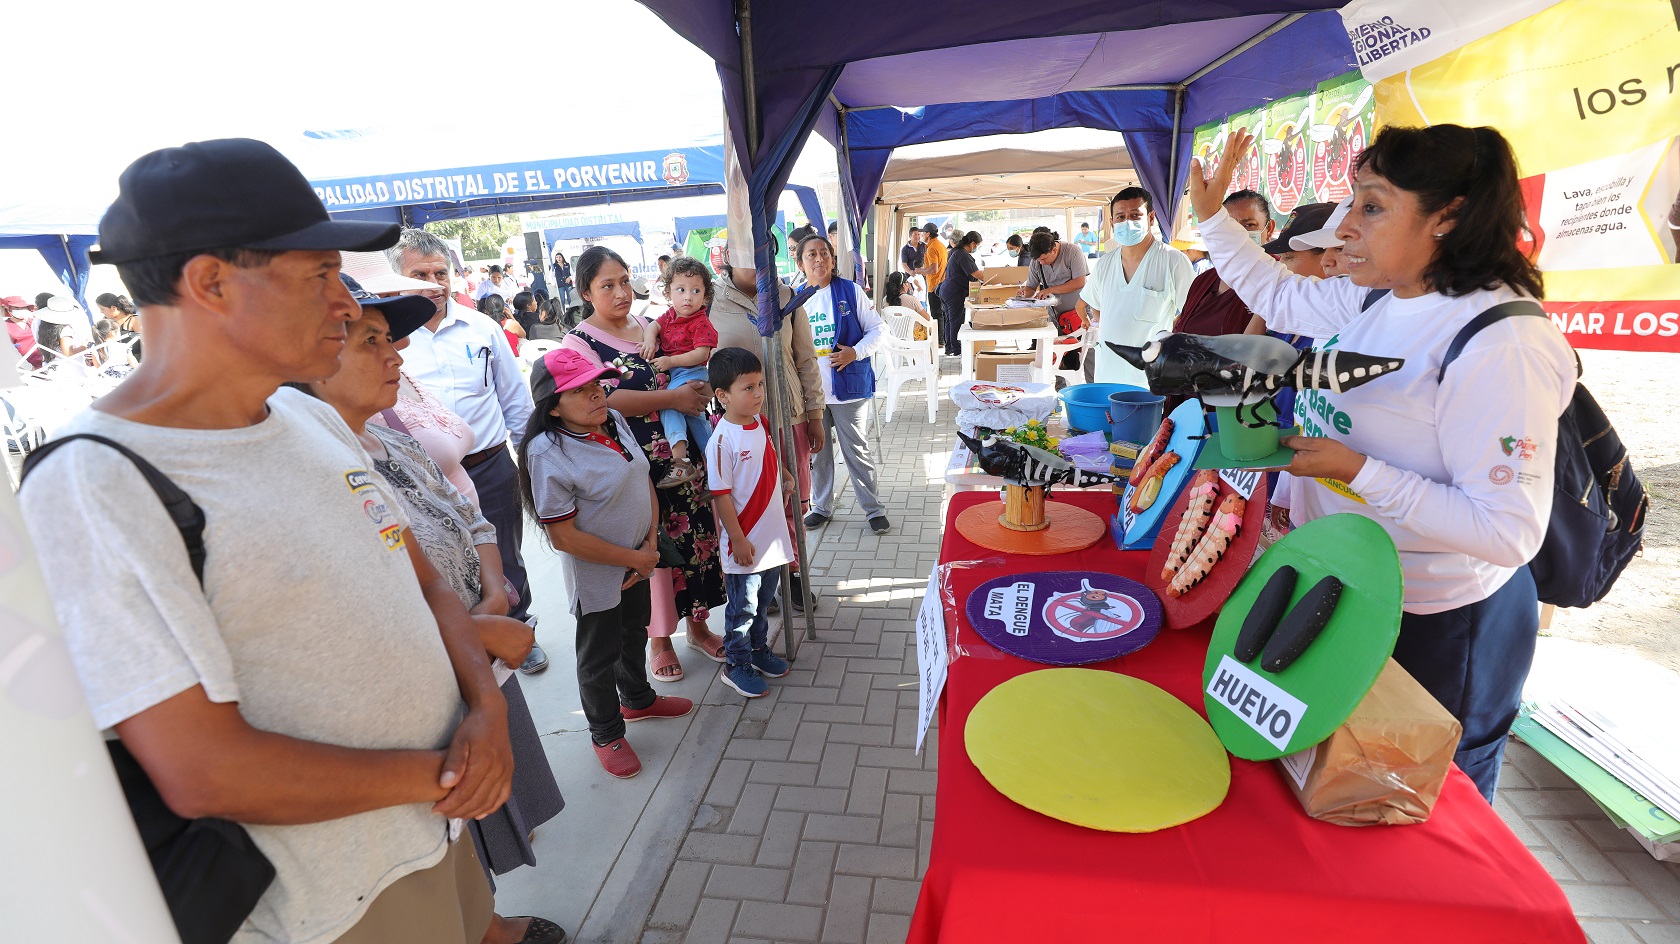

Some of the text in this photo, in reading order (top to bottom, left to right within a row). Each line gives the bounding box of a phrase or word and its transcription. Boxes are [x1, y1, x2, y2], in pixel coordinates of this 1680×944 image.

[1352, 24, 1411, 53] GIONAL
[1359, 27, 1431, 66] LIBERTAD
[1573, 78, 1647, 120] los
[392, 173, 489, 202] DISTRITAL
[493, 172, 519, 193] DE
[524, 170, 550, 191] EL
[553, 161, 658, 189] PORVENIR
[1563, 188, 1593, 200] Lava,
[1608, 193, 1621, 203] los
[525, 213, 623, 230] MUNICIPALIDAD DISTRITAL
[1600, 204, 1632, 218] donde
[1556, 221, 1627, 240] almacenas agua.
[1545, 312, 1679, 337] NAR LOS
[988, 591, 1004, 616] MATA
[1012, 583, 1030, 634] EL DENGUE
[1212, 668, 1292, 739] HUEVO
